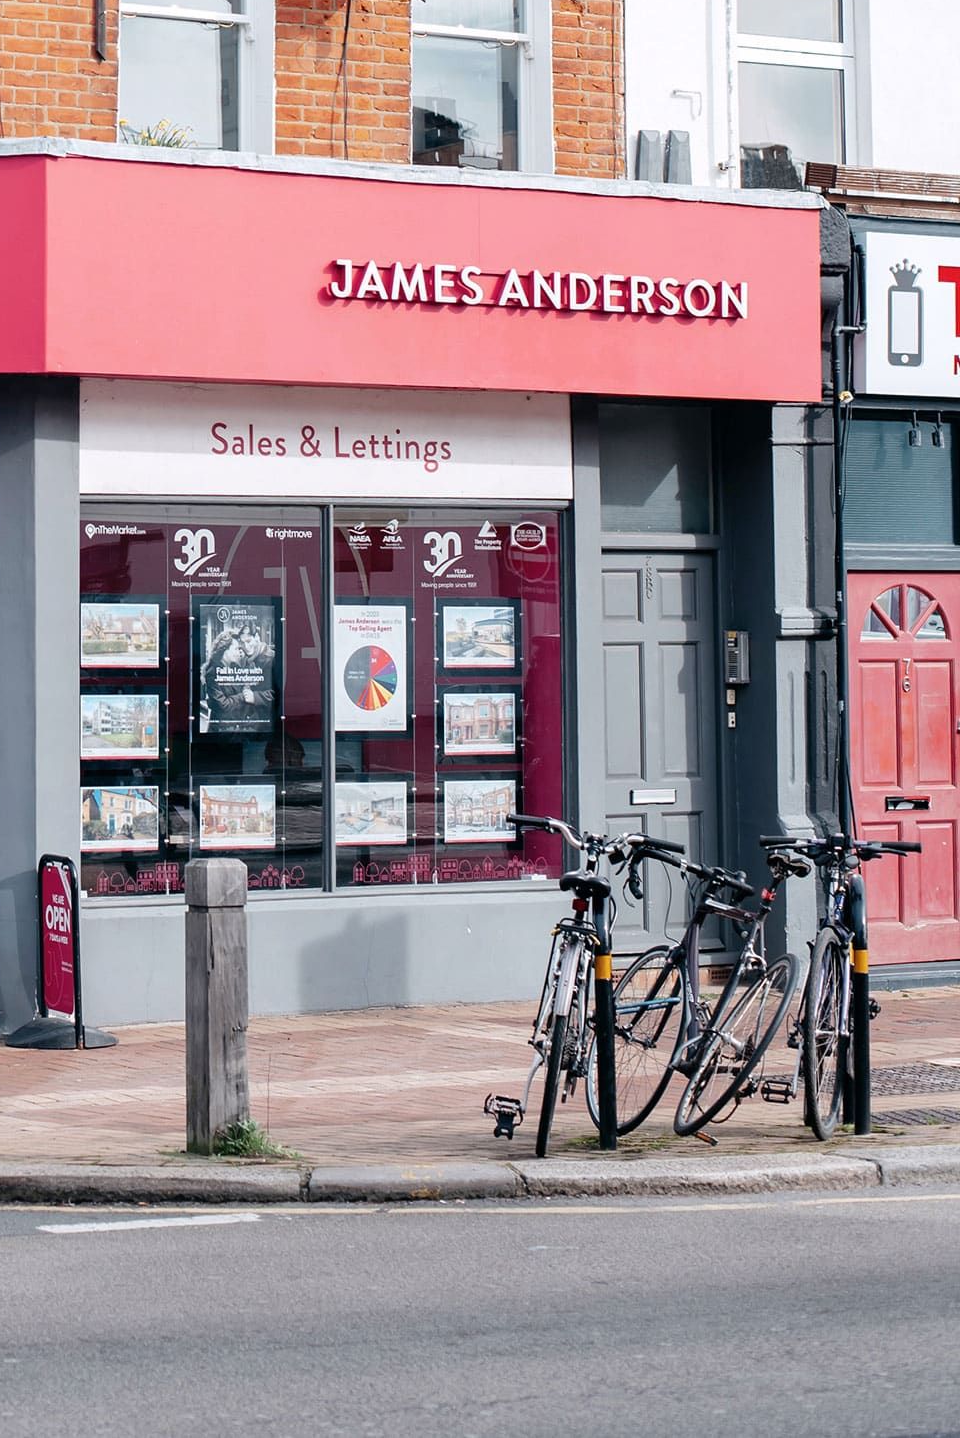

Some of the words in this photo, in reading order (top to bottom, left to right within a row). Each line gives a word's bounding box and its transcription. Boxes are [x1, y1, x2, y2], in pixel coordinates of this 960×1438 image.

[331, 259, 483, 306] JAMES
[499, 268, 749, 320] ANDERSON
[211, 422, 287, 456] Sales
[300, 425, 322, 458] &
[334, 426, 452, 473] Lettings
[174, 528, 215, 572] 30
[274, 530, 313, 541] rightmove
[349, 535, 372, 543] NAEA
[382, 535, 403, 543] ARLA
[423, 531, 462, 573] 30
[45, 905, 70, 933] OPEN
